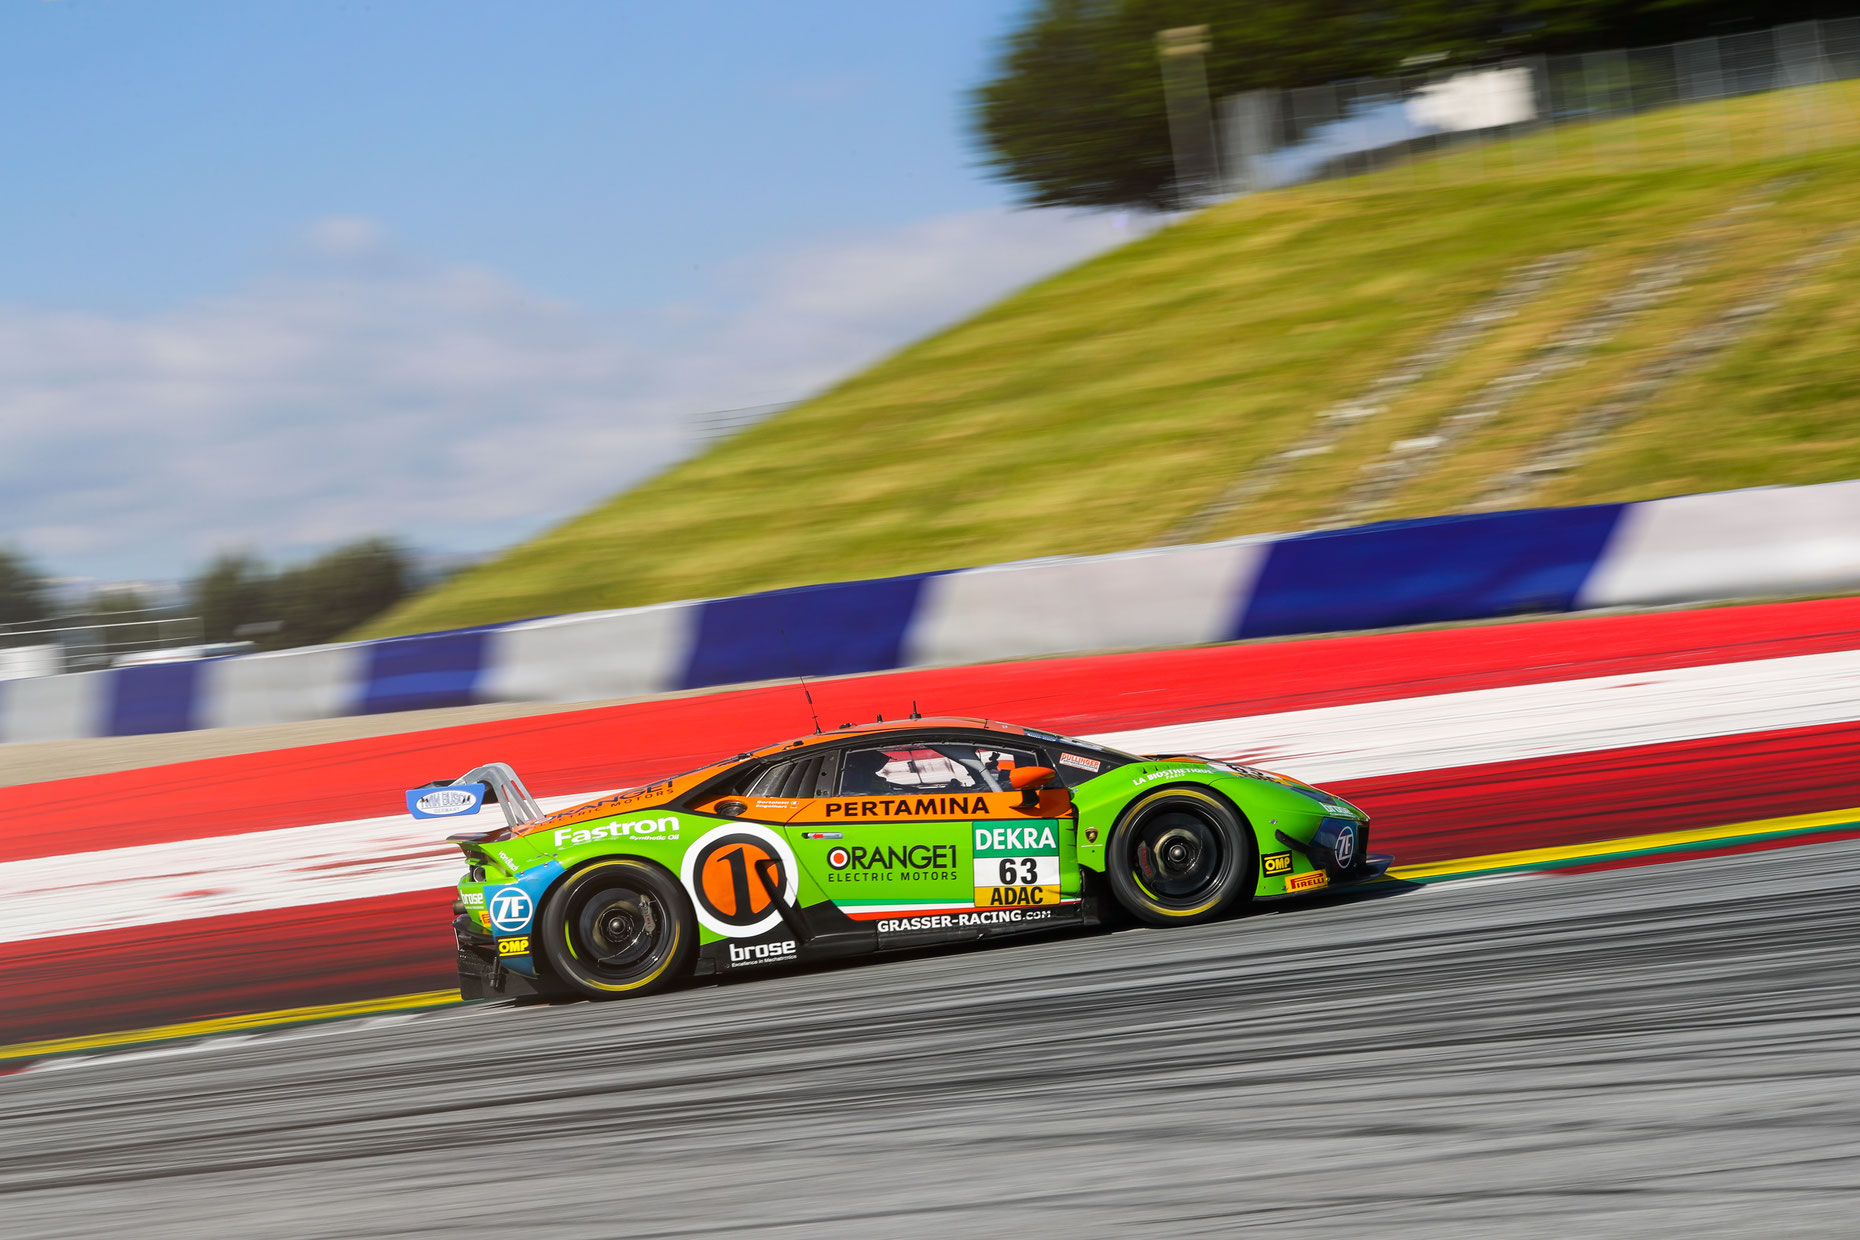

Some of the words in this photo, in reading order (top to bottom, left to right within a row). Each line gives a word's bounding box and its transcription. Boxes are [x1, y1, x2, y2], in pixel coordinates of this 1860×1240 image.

[1132, 776, 1147, 786] LA
[1146, 768, 1214, 781] BIOSTHETIQUE
[610, 788, 675, 807] MOTORS
[825, 796, 990, 817] PERTAMINA
[554, 816, 680, 847] Fastron
[975, 826, 1057, 851] DEKRA
[826, 844, 957, 871] ORANGE1
[1264, 856, 1291, 871] OMP
[828, 872, 894, 883] ELECTRIC
[900, 871, 958, 882] MOTORS
[999, 857, 1038, 886] 63
[1290, 872, 1324, 889] PIRELLI
[989, 886, 1044, 906] ADAC
[494, 896, 530, 923] ZF
[498, 939, 530, 953] OMP
[729, 940, 796, 962] brose
